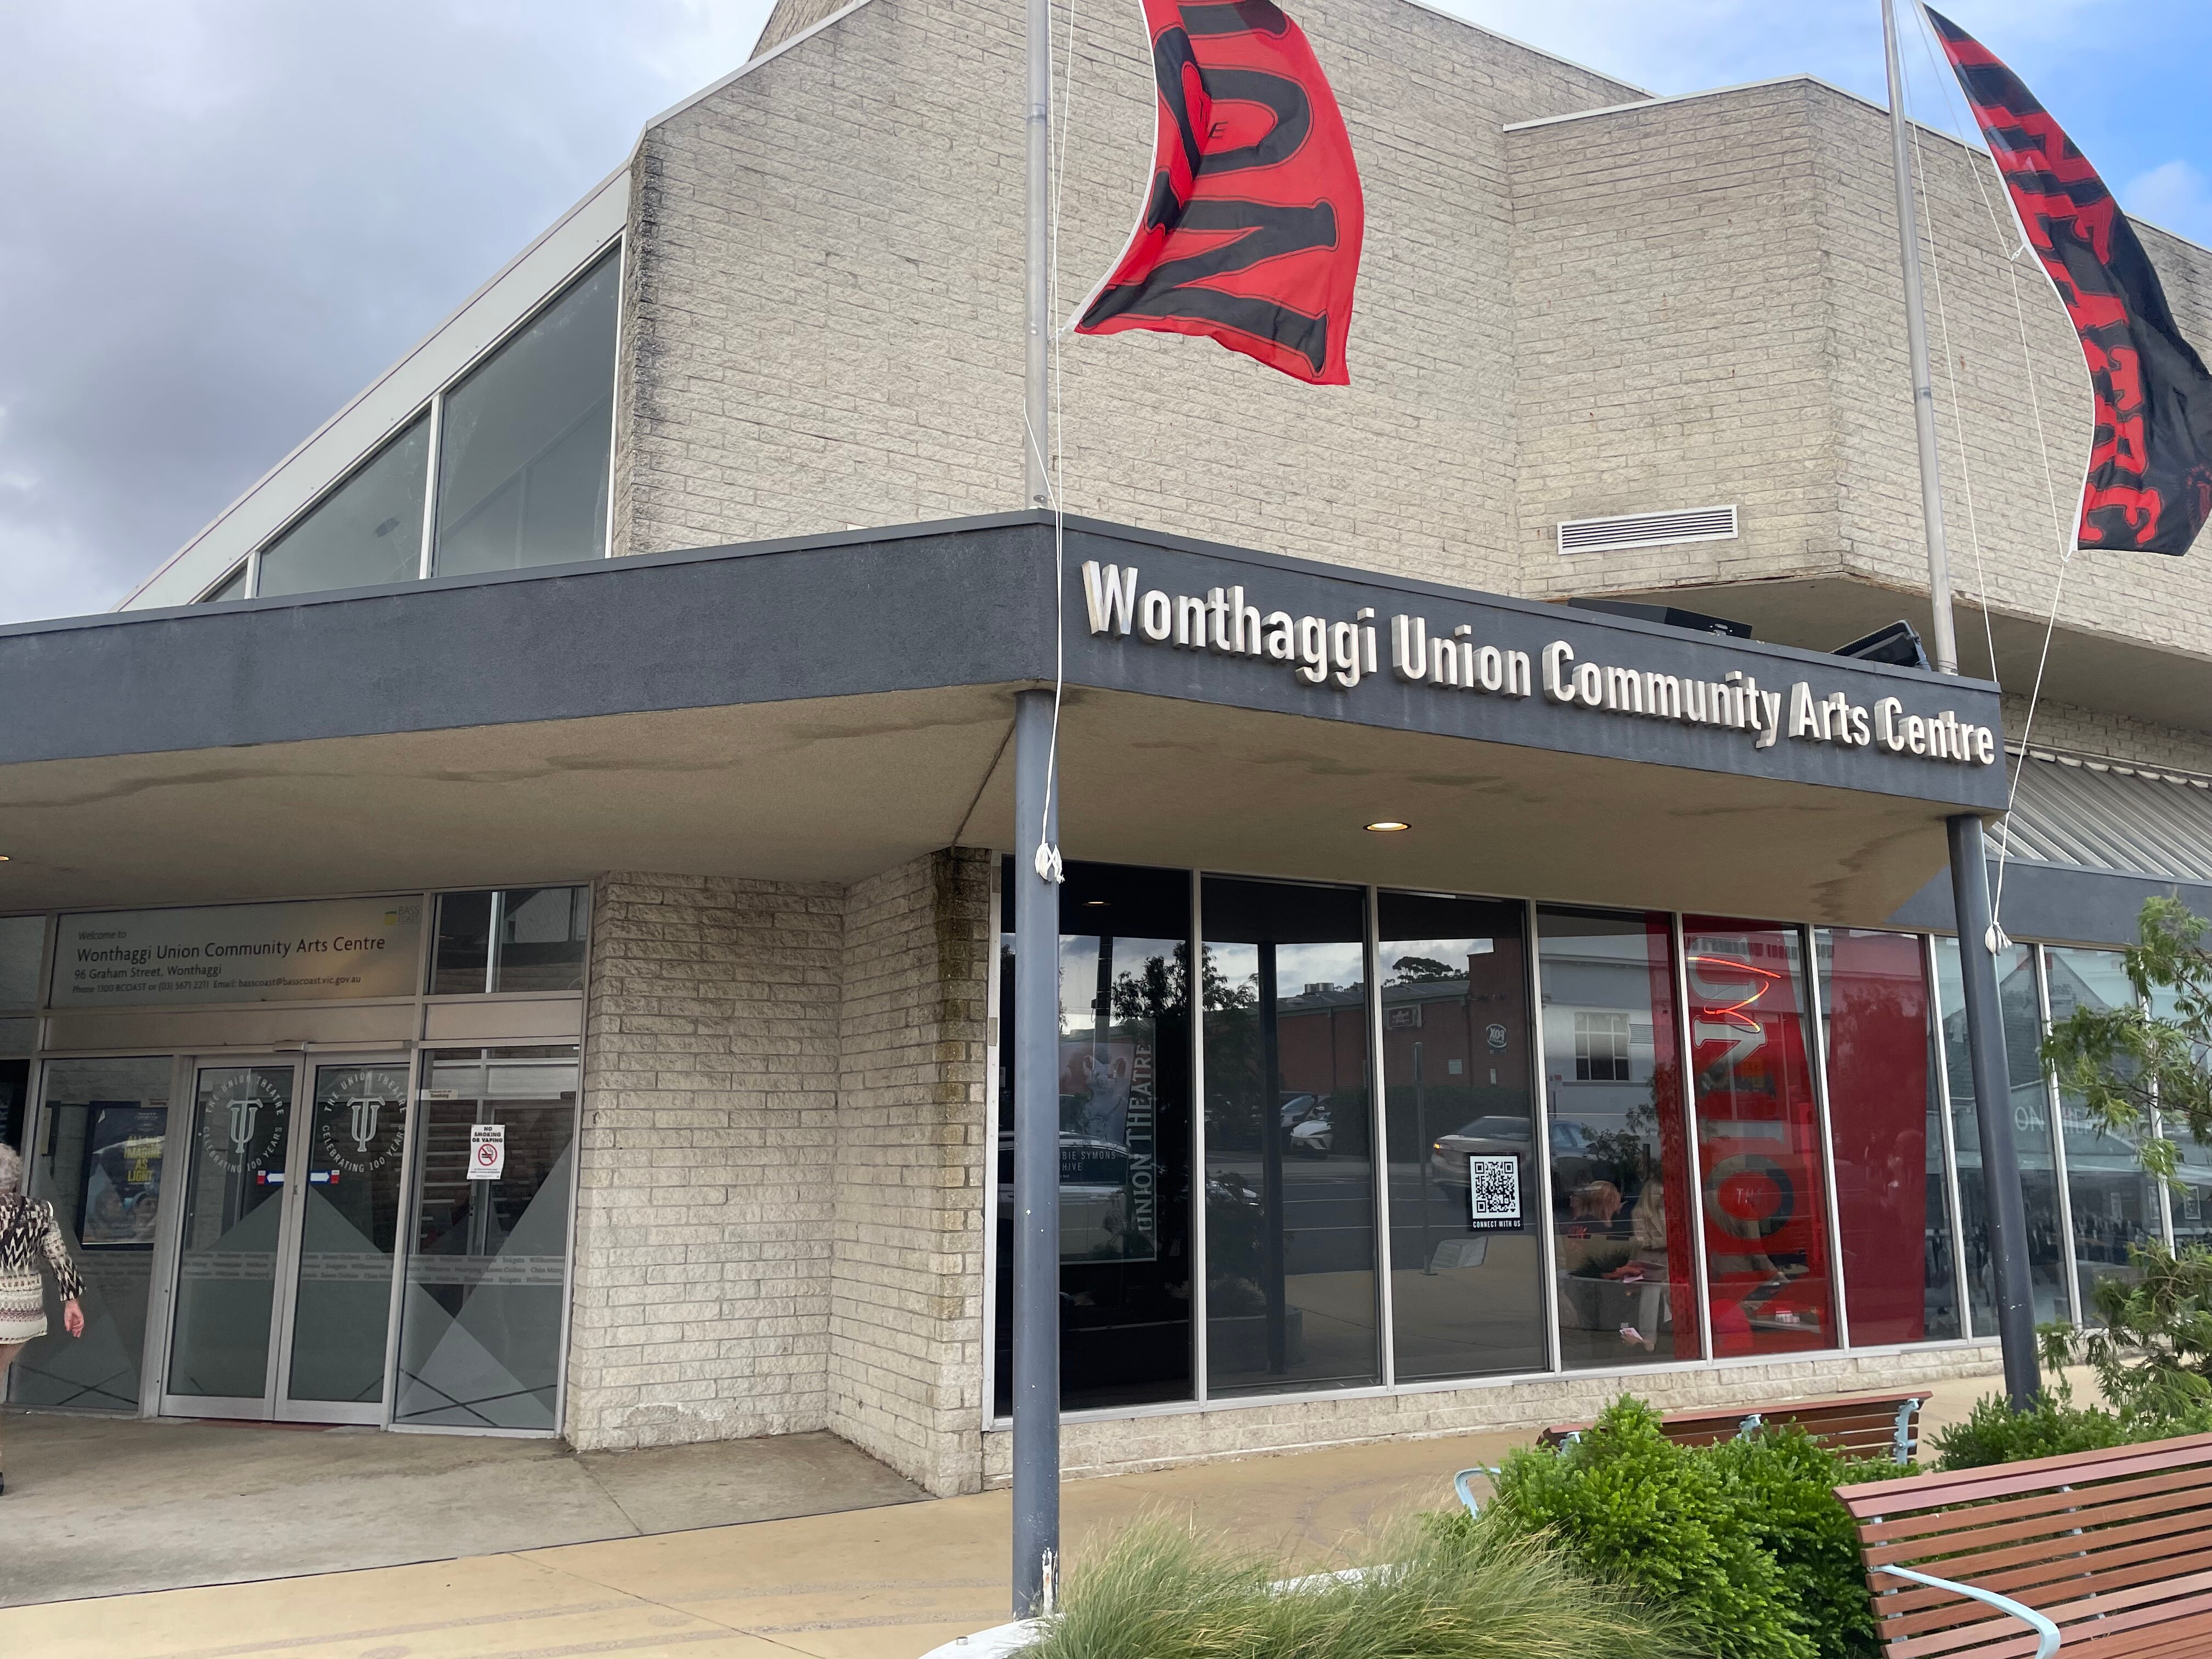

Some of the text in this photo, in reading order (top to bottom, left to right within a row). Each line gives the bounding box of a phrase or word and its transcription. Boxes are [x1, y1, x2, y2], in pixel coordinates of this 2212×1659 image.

[1081, 2, 1339, 376] ION
[1081, 560, 1995, 766] Wonthaggi Union Community Arts Centre
[398, 906, 420, 916] BASS
[77, 936, 386, 964] Wonthaggi Union Community Arts Centre
[78, 932, 116, 940] Welcome
[74, 964, 222, 980] 96 Graham Street, Wonthaggi
[115, 983, 148, 992] BCOAST
[158, 982, 173, 992] (03)
[174, 981, 191, 990] 5671
[213, 979, 236, 989] Email:
[238, 975, 362, 988] basscoast@basscoast.vic.gov.au
[206, 1093, 219, 1114] THE
[256, 1076, 284, 1116] THEATRE
[324, 1091, 340, 1112] THE
[377, 1073, 407, 1114] THEATRE
[203, 1126, 283, 1173] CELEBRATING 100 YEARS
[322, 1125, 405, 1173] CELEBRATING 100 YEARS
[1126, 1043, 1153, 1231] UNION THEATRE
[1688, 935, 1822, 1335] UNION
[1060, 1151, 1116, 1160] BIE SYMONS
[1060, 1162, 1083, 1171] HIVE
